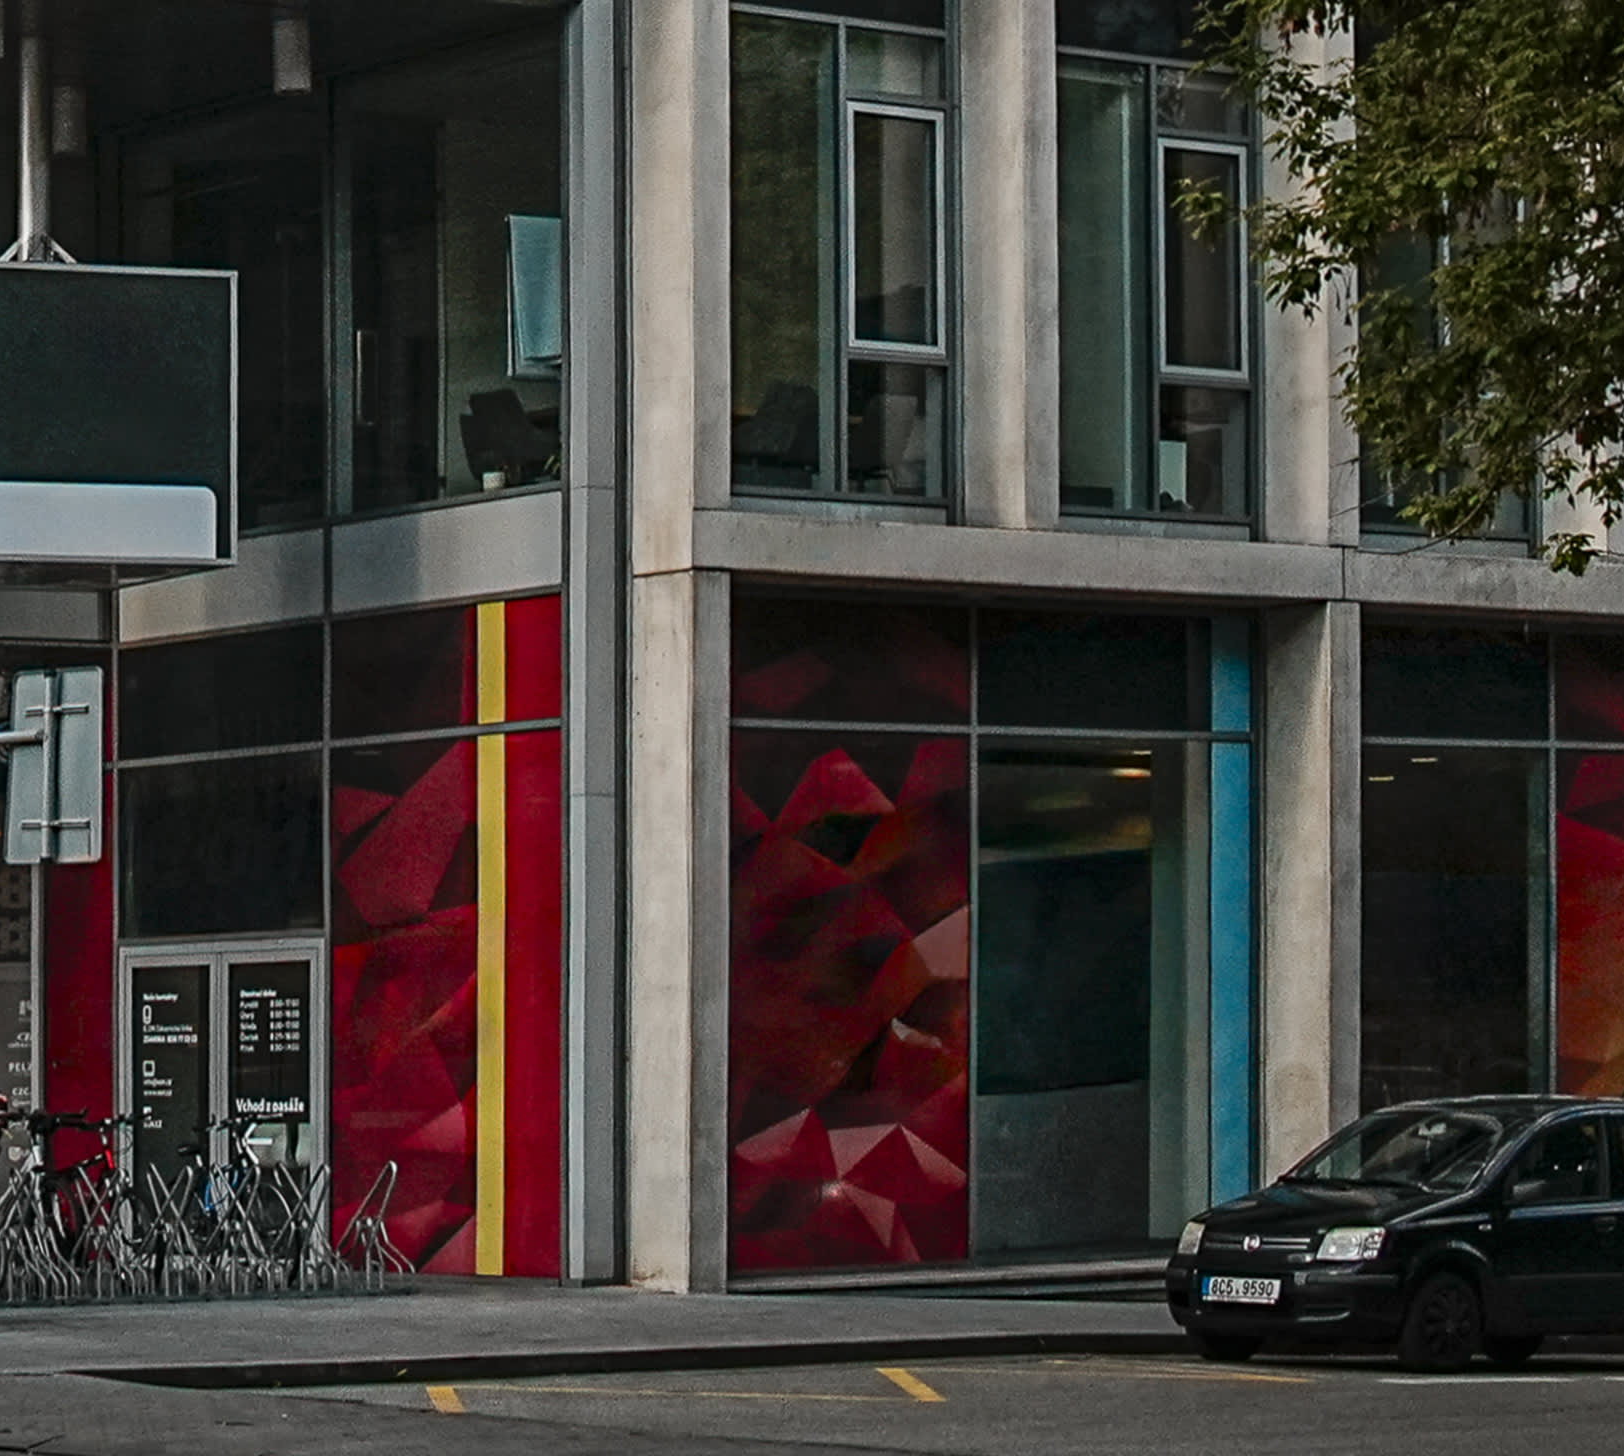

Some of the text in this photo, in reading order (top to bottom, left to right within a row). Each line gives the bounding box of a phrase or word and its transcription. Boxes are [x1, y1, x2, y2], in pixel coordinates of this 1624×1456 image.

[236, 1097, 265, 1113] Vchod
[1212, 1278, 1275, 1297] 8C5 9590
